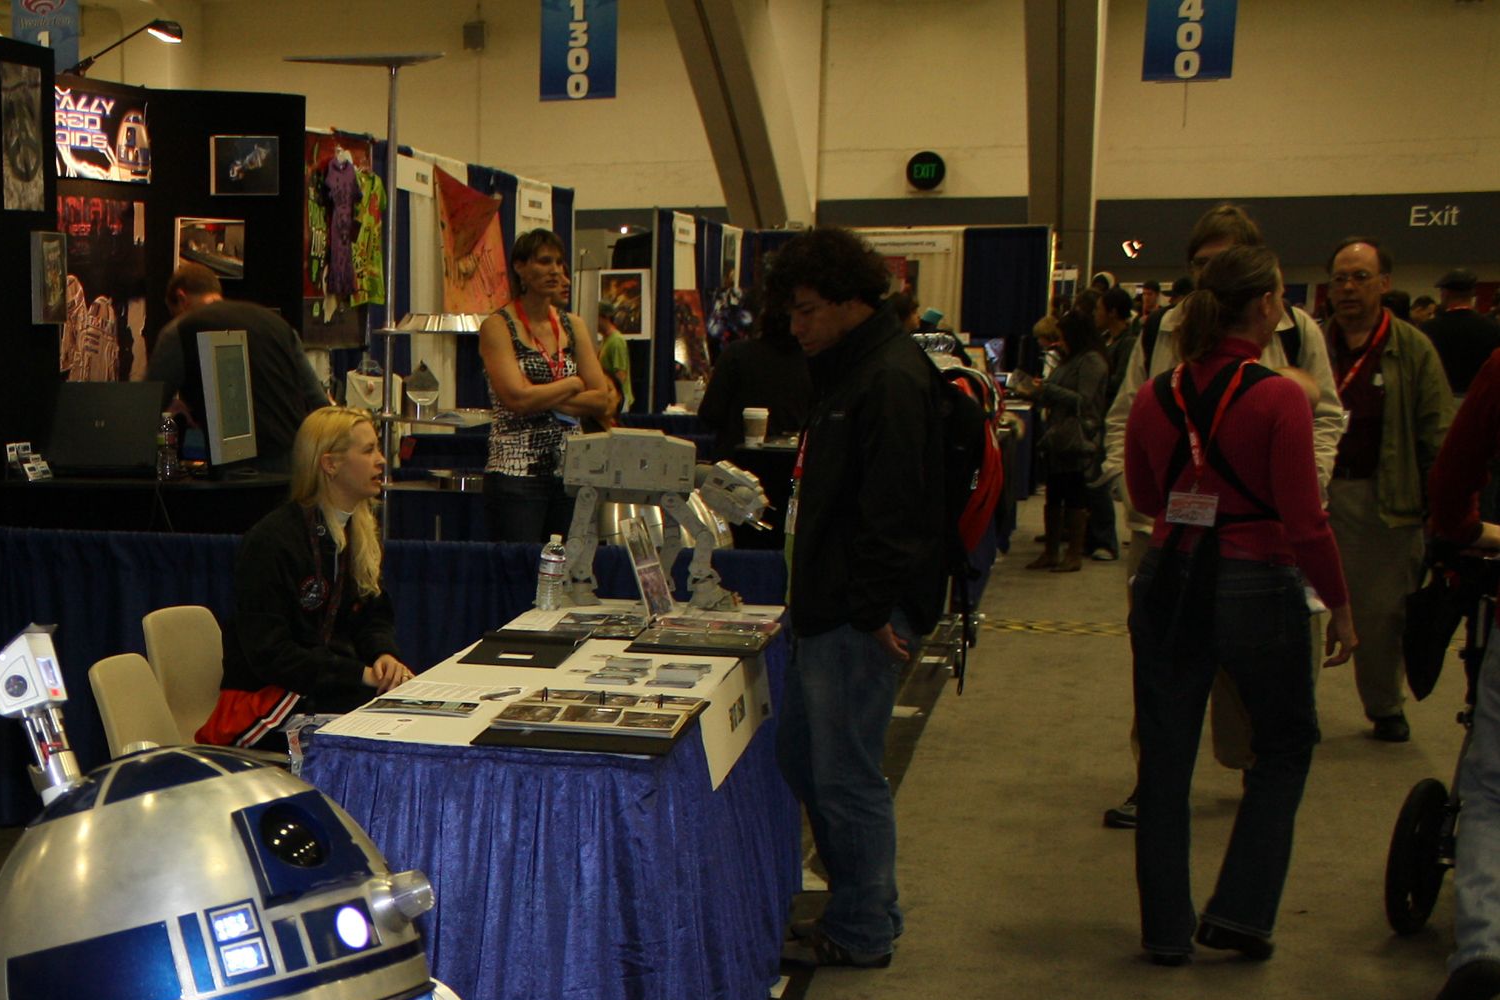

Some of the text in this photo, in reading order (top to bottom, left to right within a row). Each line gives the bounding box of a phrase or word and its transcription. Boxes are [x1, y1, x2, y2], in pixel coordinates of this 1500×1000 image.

[566, 0, 590, 99] 1300
[56, 94, 116, 115] ALLY
[913, 163, 938, 179] EXIT
[1409, 204, 1460, 227] Exit
